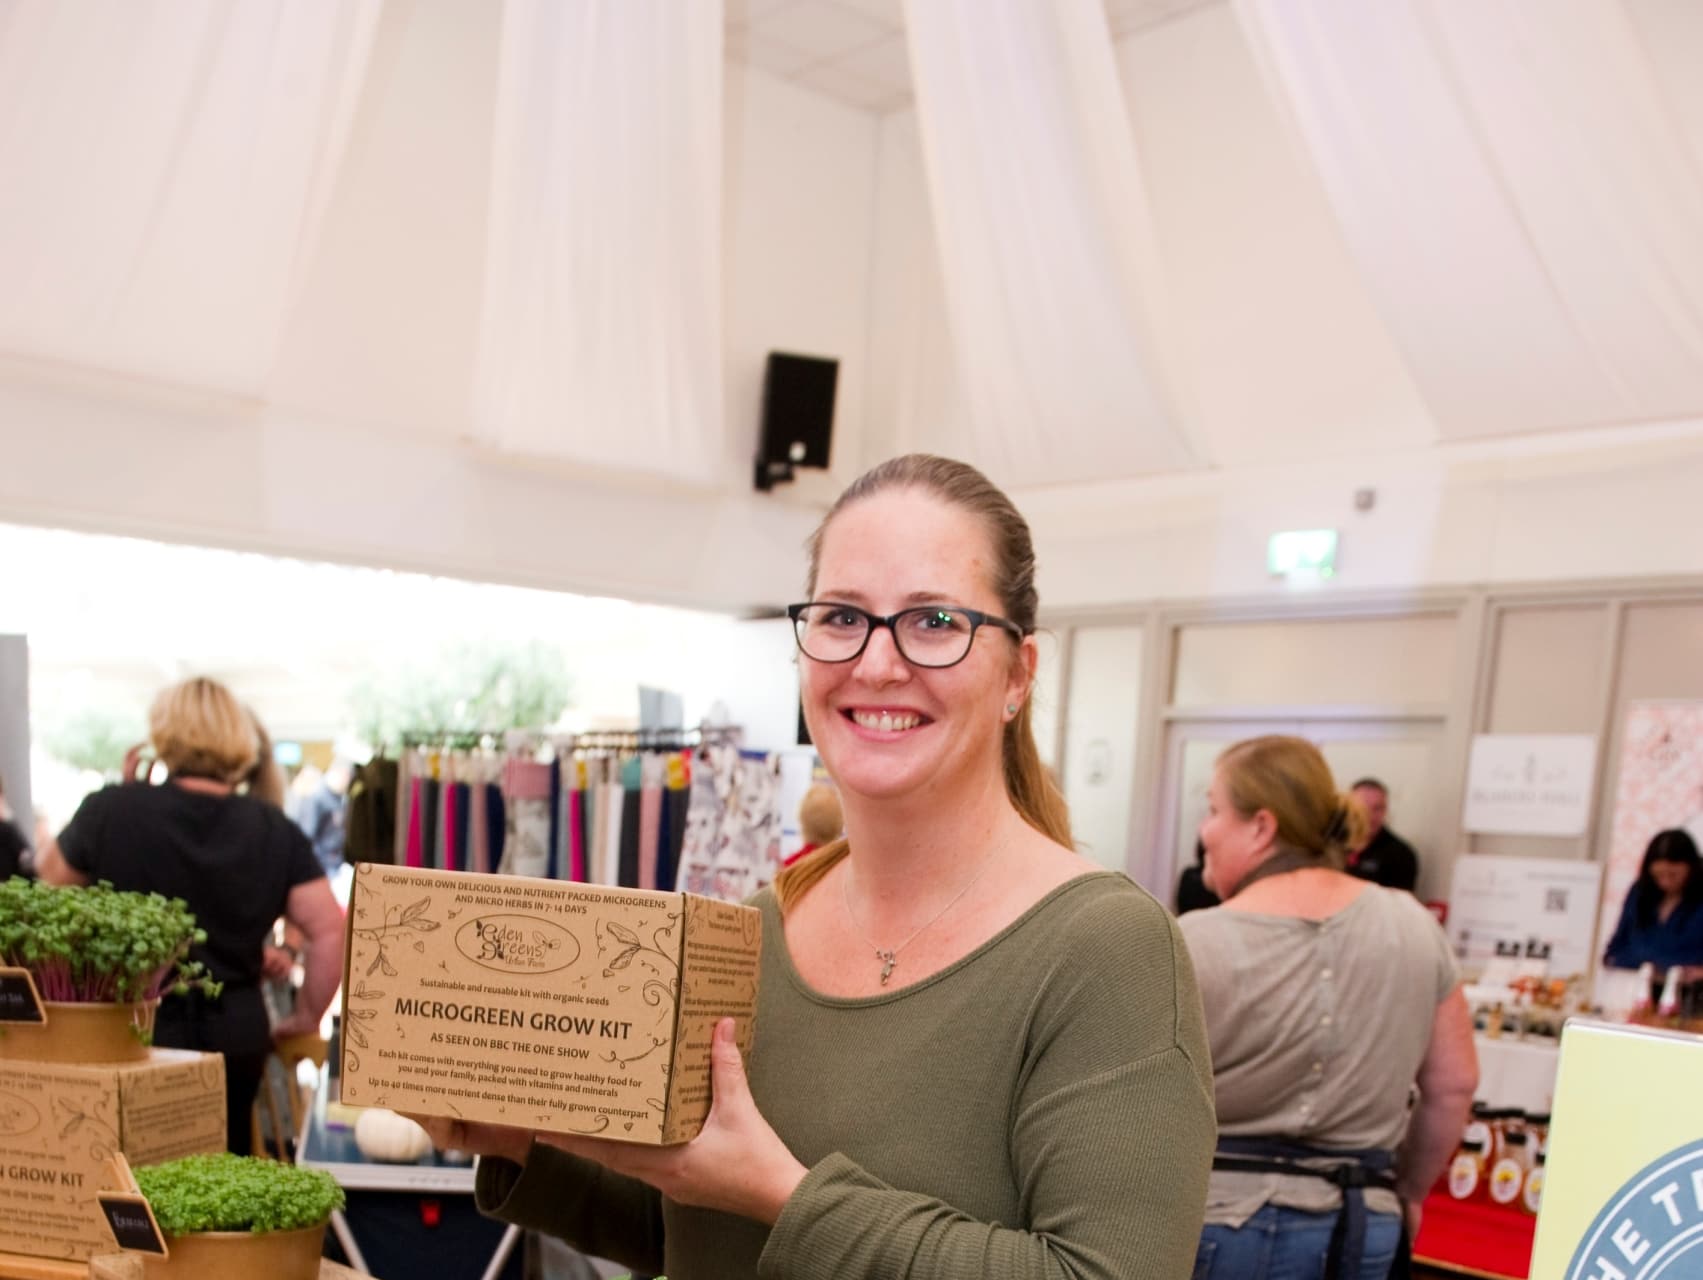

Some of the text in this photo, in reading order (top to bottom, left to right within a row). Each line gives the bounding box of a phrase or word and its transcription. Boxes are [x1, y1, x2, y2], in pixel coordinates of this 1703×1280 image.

[382, 875, 666, 909] GROW YOUR OWN DELICIOUS AND NUTRIENT PACKED MICROGREENS
[454, 894, 473, 904] AND
[474, 896, 503, 907] MICRO
[504, 899, 532, 909] HERBS
[533, 901, 543, 910] IN
[564, 904, 587, 915] DAYS
[419, 978, 610, 1006] Sustainable and reusable kit with organic seeds
[394, 997, 633, 1040] MICROGREEN GROW KIT
[429, 1032, 590, 1059] AS SEEN ON BBC THE ONE SHOW
[378, 1048, 643, 1088] Each kit comes with everything you need to grow healthy food for
[397, 1064, 618, 1097] you and your family, packed with vitamins and minerals
[368, 1076, 379, 1087] Up
[380, 1079, 389, 1087] to
[401, 1081, 423, 1092] times
[424, 1085, 446, 1095] more
[447, 1088, 480, 1099] nutrient
[481, 1091, 505, 1102] dense
[506, 1094, 526, 1104] than
[527, 1096, 547, 1107] their
[548, 1098, 567, 1111] fully
[568, 1103, 596, 1113] grown
[597, 1107, 649, 1119] counterpart
[9, 1165, 85, 1188] GROW KIT
